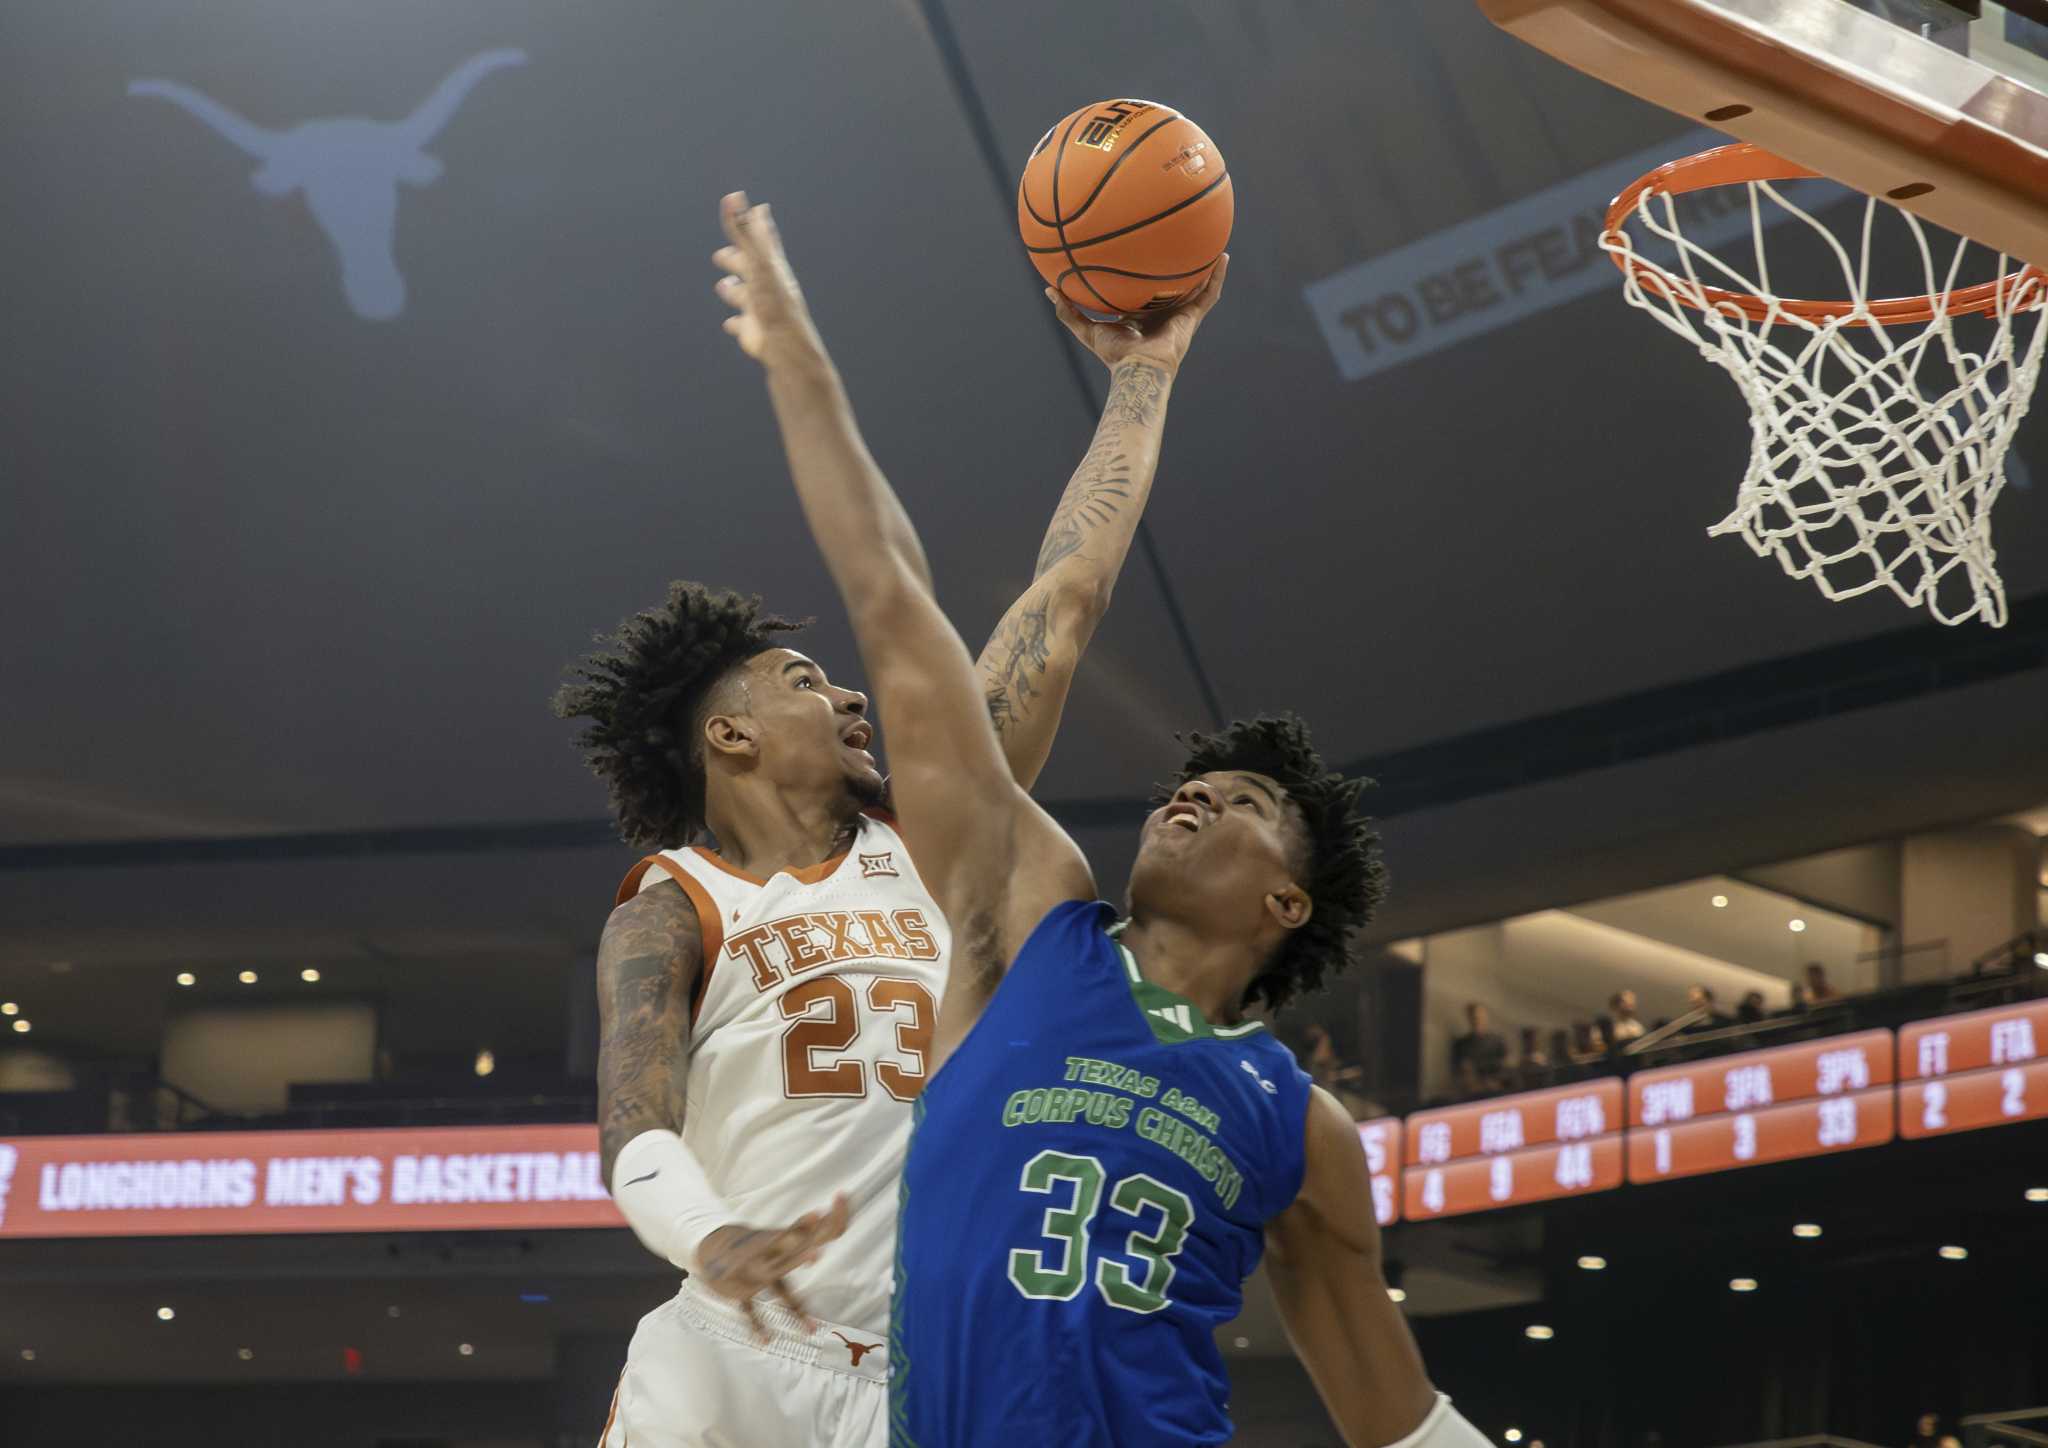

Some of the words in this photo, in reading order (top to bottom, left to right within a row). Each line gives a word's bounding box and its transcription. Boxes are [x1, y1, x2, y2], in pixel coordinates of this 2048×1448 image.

[1341, 289, 1418, 353] TO
[724, 908, 941, 993] TEXAS
[776, 972, 938, 1104] 23
[1917, 1031, 1951, 1078] FT
[1990, 1017, 2037, 1065] FTA
[1063, 1055, 1161, 1099] TEXAS
[1160, 1087, 1222, 1136] A&M
[1654, 1127, 1672, 1175] 1
[1732, 1112, 1758, 1161] 3
[1817, 1096, 1858, 1147] 33
[1922, 1081, 1948, 1130] 2
[2001, 1068, 2028, 1117] 2
[38, 1158, 257, 1211] LONGHORNS
[264, 1155, 383, 1207] MEN'S
[391, 1150, 613, 1204] BASKETBAL
[1002, 1086, 1135, 1129] CORPUS
[1135, 1107, 1245, 1212] CHRISTI
[1007, 1148, 1196, 1315] 33
